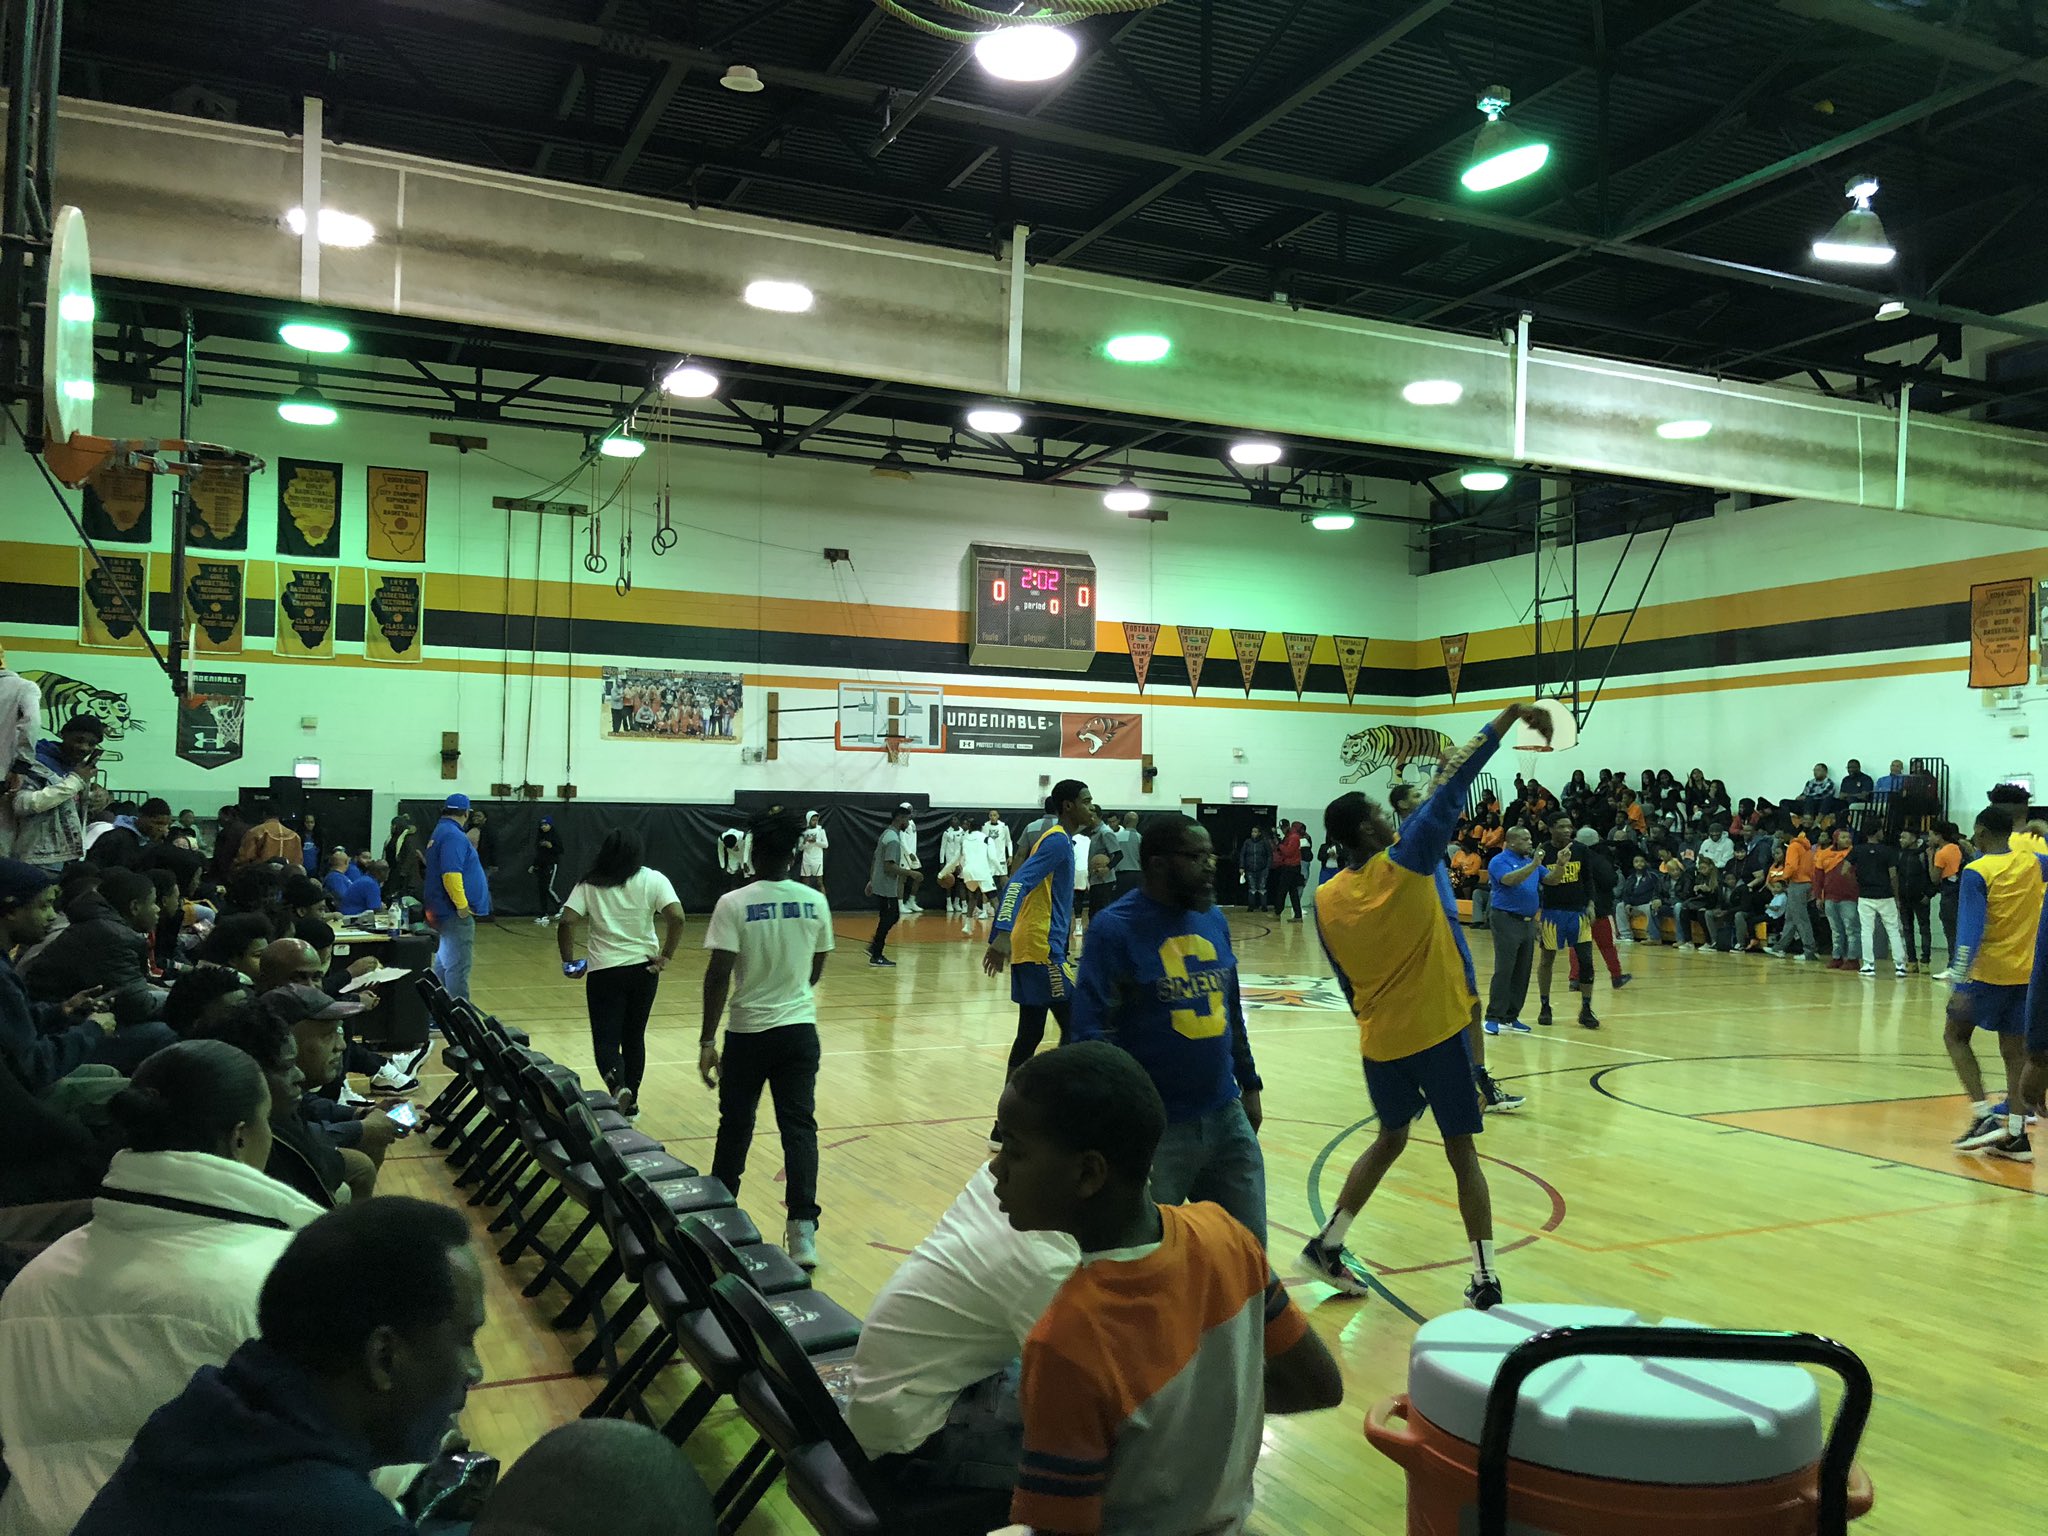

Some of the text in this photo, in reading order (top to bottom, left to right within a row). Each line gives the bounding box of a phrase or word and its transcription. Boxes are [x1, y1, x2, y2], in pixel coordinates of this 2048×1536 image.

[1021, 567, 1059, 591] 2:02
[993, 580, 1006, 602] 0
[1078, 587, 1089, 607] 0
[1024, 599, 1059, 615] period 0
[1126, 624, 1157, 633] FOOTBALL
[1181, 628, 1209, 636] FOOTBALL
[1234, 632, 1262, 641] FOOTBALL
[1286, 635, 1313, 643] FOOTBALL
[190, 675, 238, 683] NDENIABLE
[947, 712, 1047, 730] UNDENIABLE
[997, 882, 1023, 922] WOLVERINES
[745, 902, 777, 922] JUST
[782, 902, 800, 919] DO
[1158, 933, 1228, 1040] S
